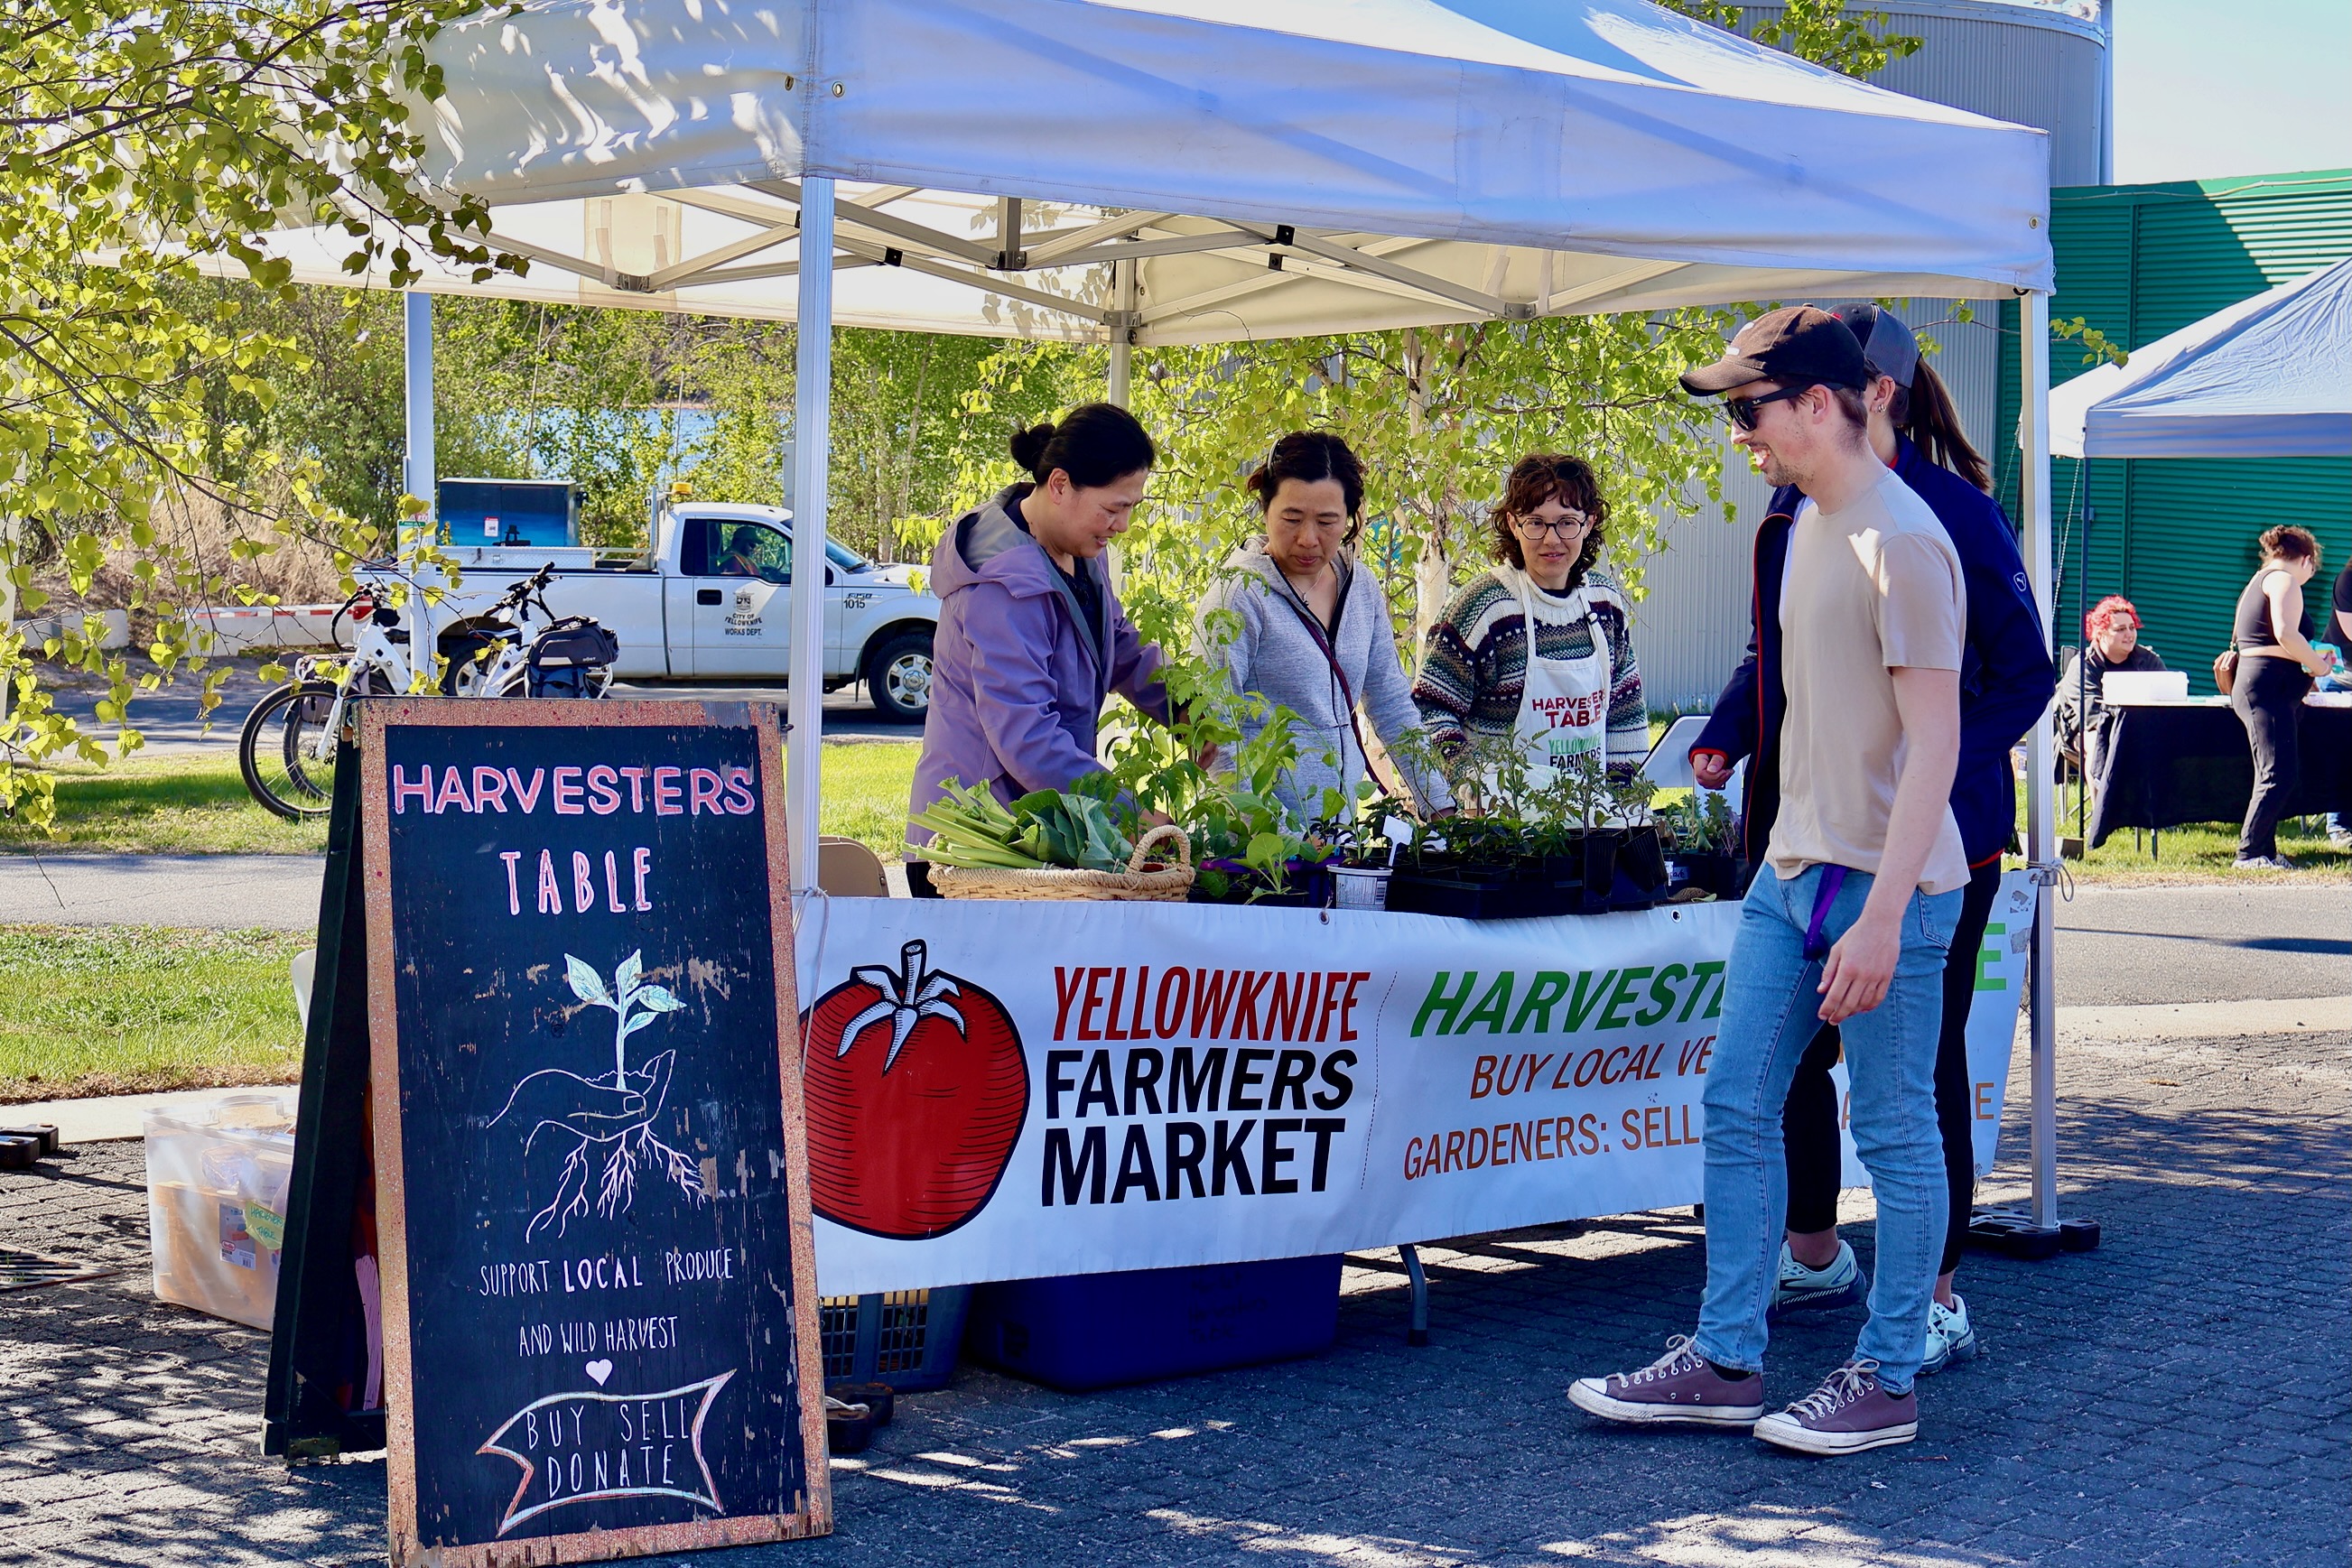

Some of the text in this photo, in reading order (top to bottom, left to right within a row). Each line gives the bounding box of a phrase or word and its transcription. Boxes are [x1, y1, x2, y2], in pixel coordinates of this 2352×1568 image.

[724, 617, 763, 626] YELLOWKNIFE
[844, 598, 866, 609] 1015
[724, 627, 746, 636] WORKS
[394, 764, 756, 816] HARVESTERS
[499, 846, 652, 916] TABLE
[1052, 965, 1371, 1044] YELLOWKNIFE
[1045, 1046, 1359, 1120] FARMERS
[1469, 1053, 1554, 1100] BUY
[1551, 1042, 1667, 1090] LOCAL
[1040, 1117, 1347, 1208] MARKET
[1402, 1103, 1700, 1182] GARDENERS: SELL
[479, 1248, 734, 1297] SUPPORT LOCAL PRODUCE
[519, 1315, 678, 1357] AND WILD HARVEST
[525, 1398, 691, 1451] BUY SELL
[547, 1444, 674, 1498] DONATE
